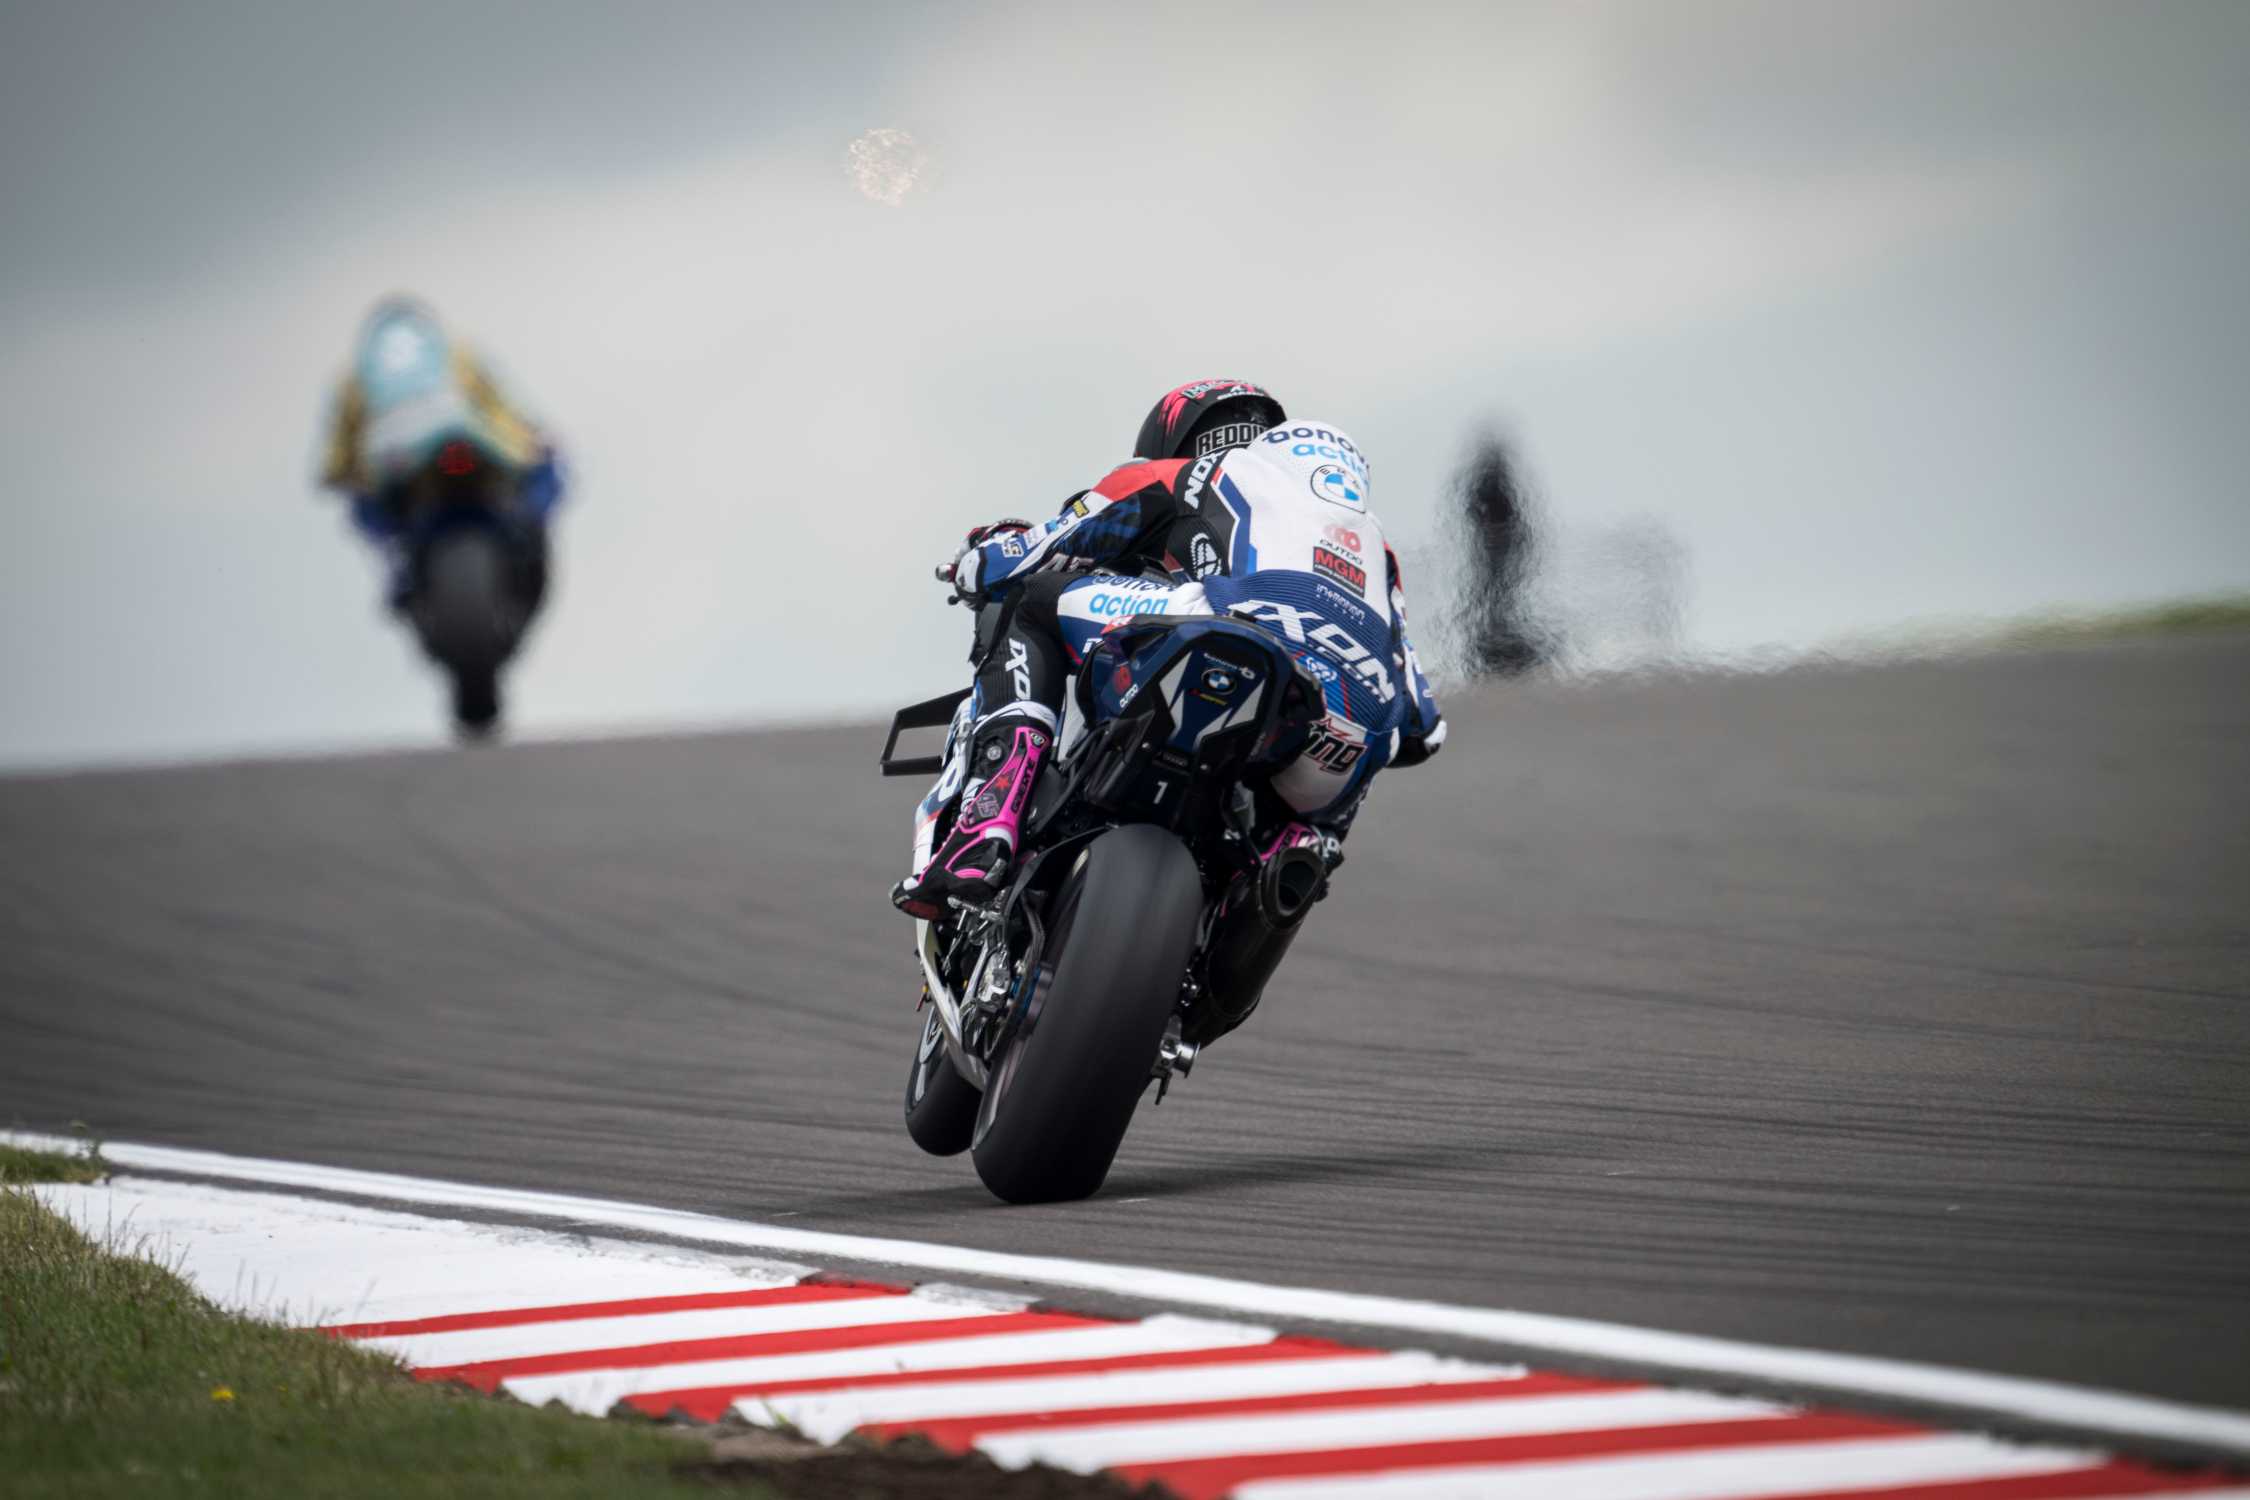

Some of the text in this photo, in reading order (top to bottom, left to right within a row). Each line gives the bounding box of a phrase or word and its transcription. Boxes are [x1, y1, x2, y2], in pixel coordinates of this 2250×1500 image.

[1314, 548, 1365, 590] MGM
[1088, 592, 1169, 616] action
[1004, 637, 1032, 701] IXO
[1227, 599, 1397, 702] IXON
[1153, 780, 1168, 804] 1
